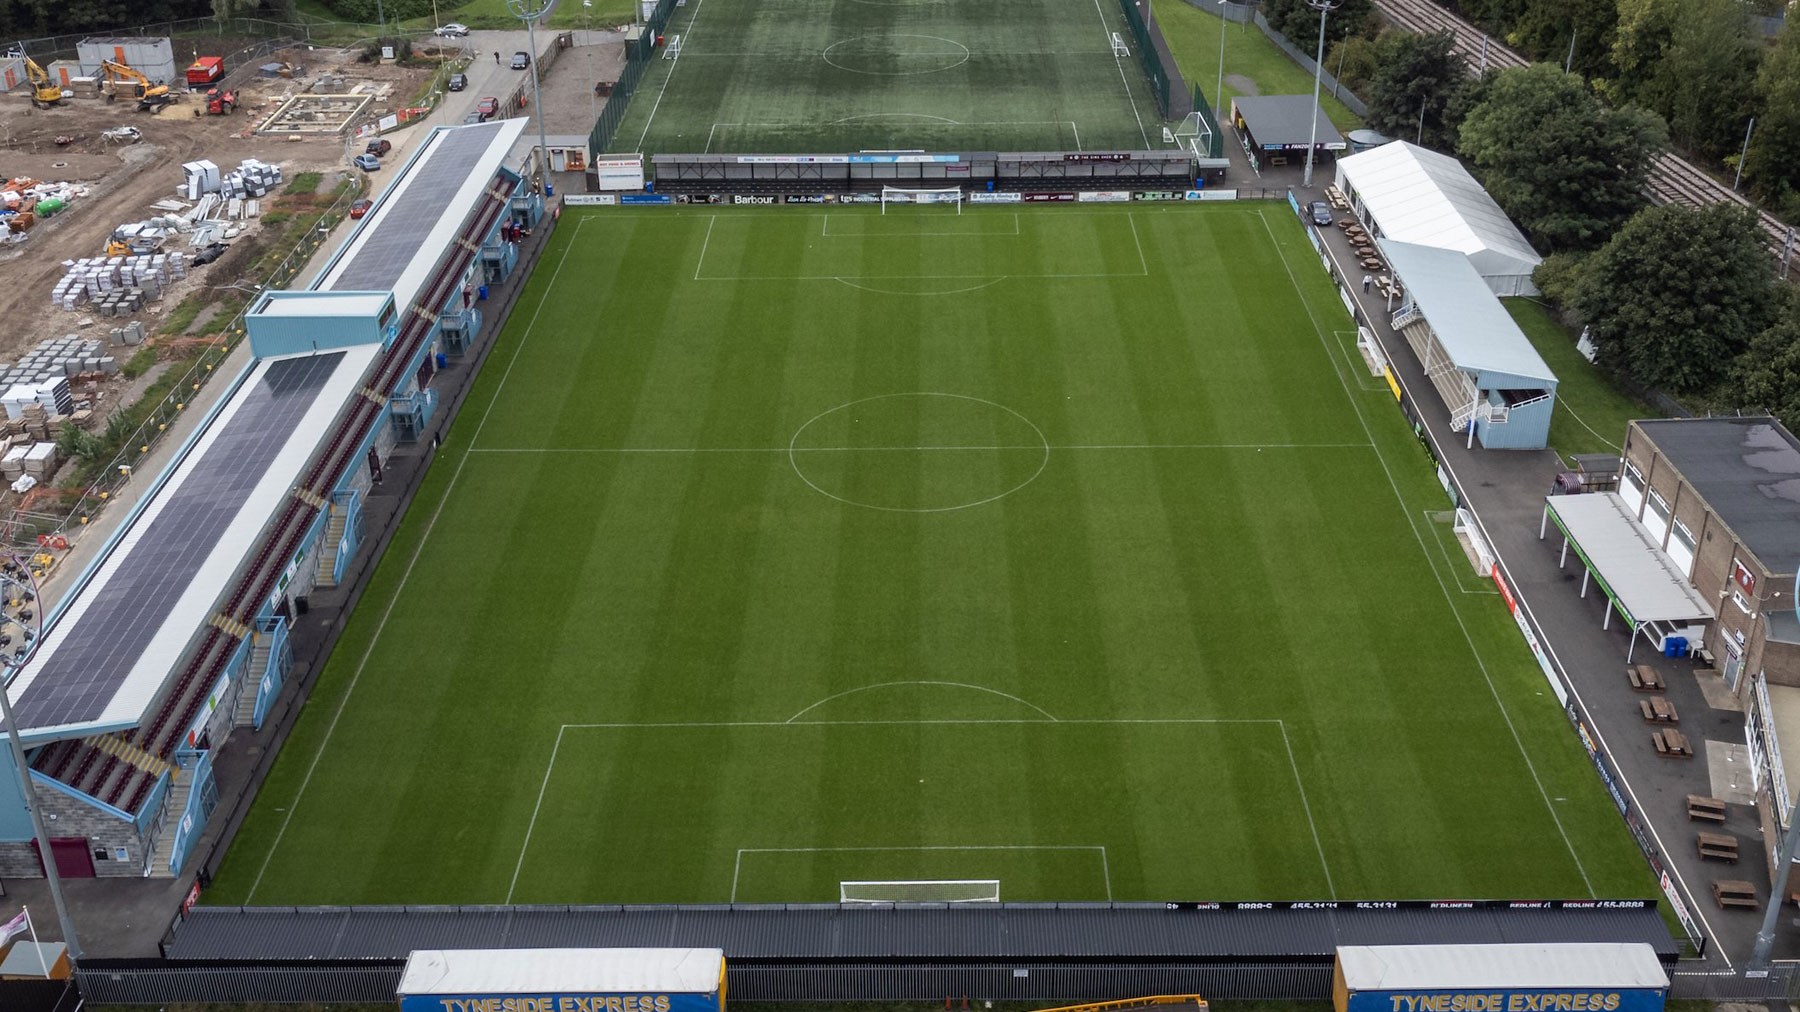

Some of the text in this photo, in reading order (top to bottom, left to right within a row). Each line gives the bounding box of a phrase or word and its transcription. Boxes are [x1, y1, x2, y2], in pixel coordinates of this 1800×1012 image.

[734, 195, 774, 204] Barbour
[440, 995, 671, 1012] TYNESIDE EXPRESS
[1390, 993, 1621, 1012] TYNESIDE EXPRESS
